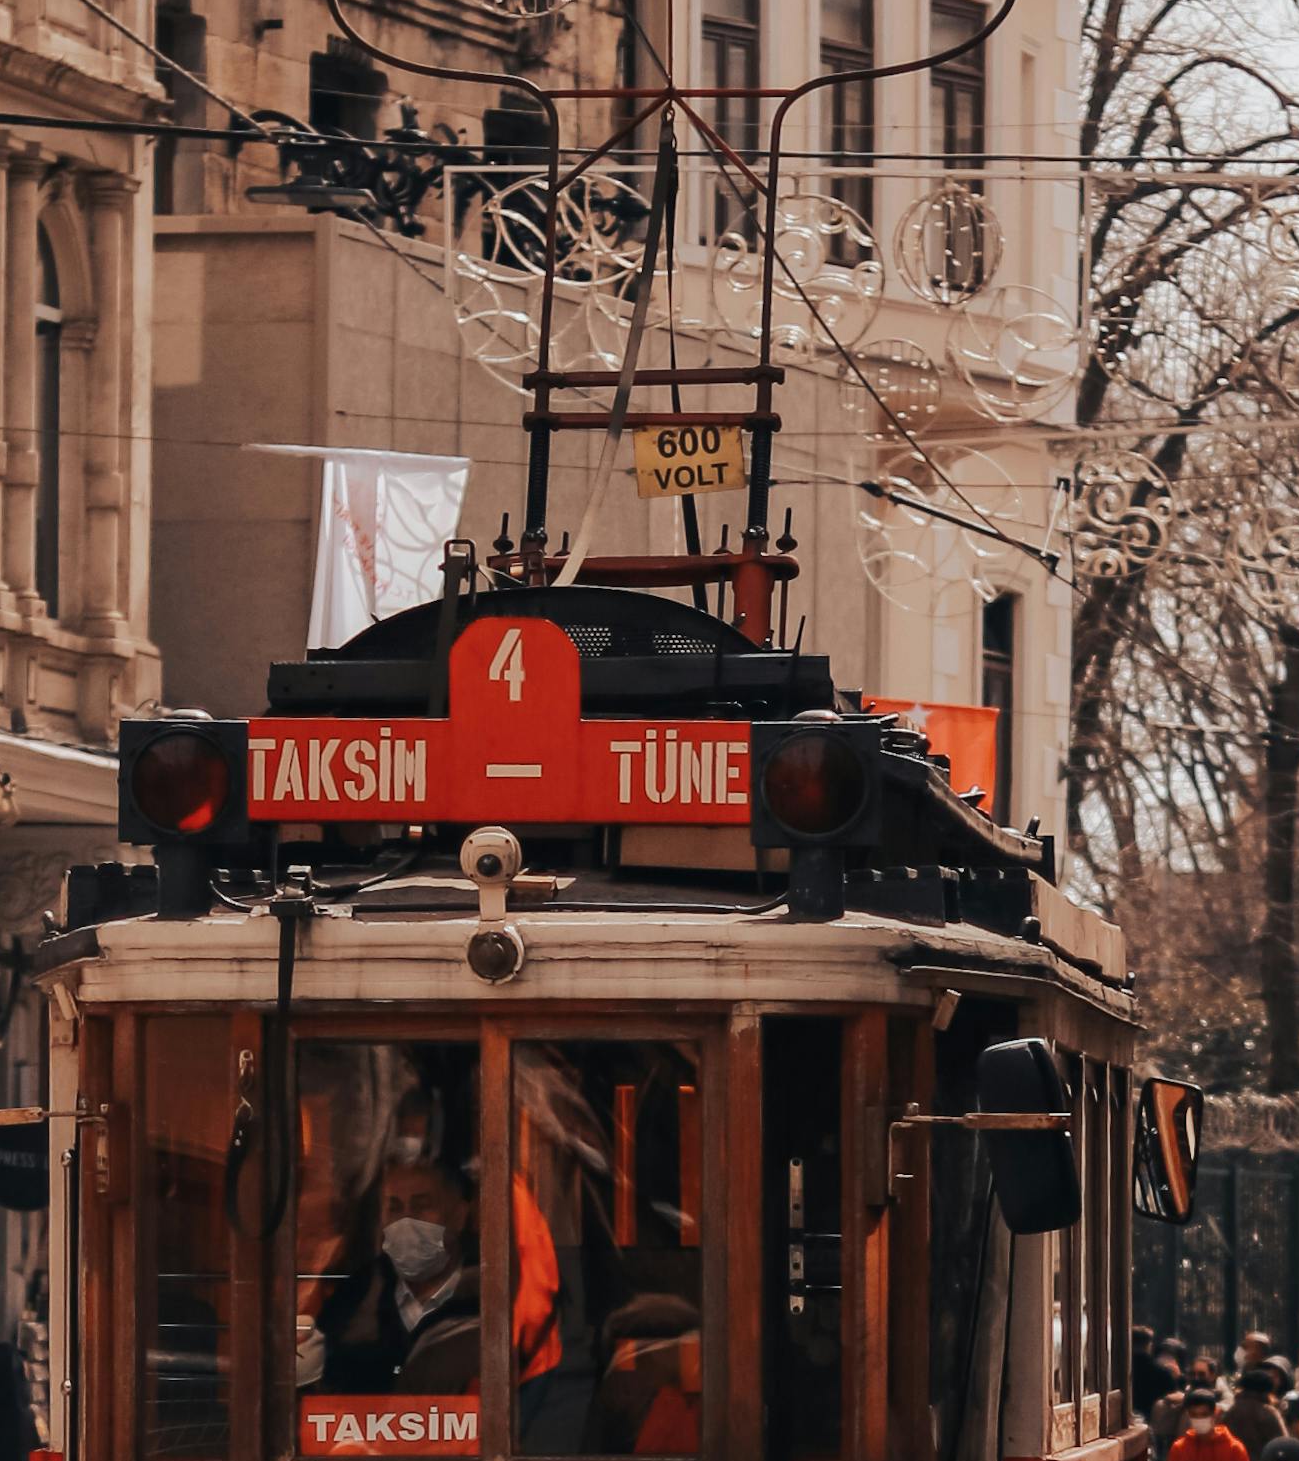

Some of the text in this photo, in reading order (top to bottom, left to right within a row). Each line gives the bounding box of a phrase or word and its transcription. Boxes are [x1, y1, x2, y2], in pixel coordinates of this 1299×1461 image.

[656, 425, 722, 458] 600
[653, 461, 729, 491] VOLT
[489, 628, 525, 702] 4
[248, 727, 427, 802] TAKSİM
[610, 729, 748, 804] TÜNE
[307, 1406, 478, 1442] TAKSİM
